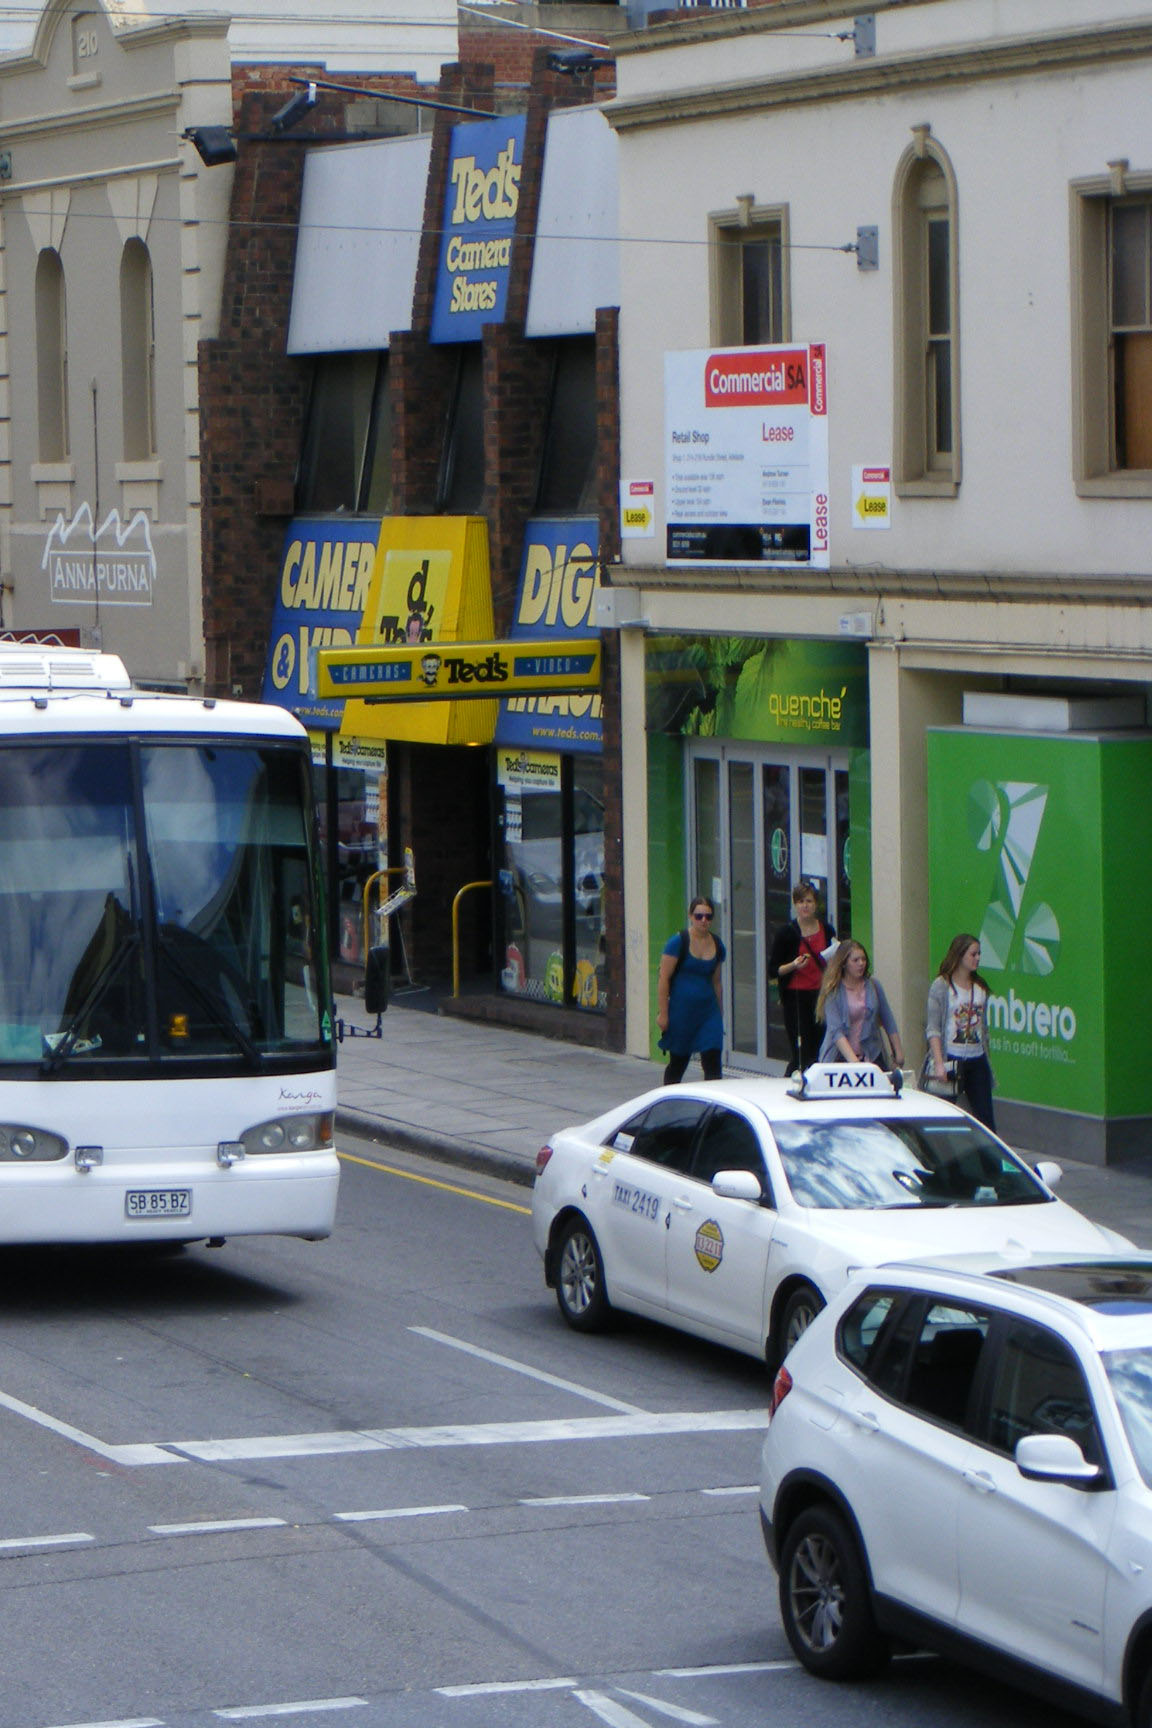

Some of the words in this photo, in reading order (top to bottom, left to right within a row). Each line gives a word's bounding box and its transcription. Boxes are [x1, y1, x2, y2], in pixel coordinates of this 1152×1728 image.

[451, 138, 522, 224] Ted's
[447, 236, 511, 272] Camera
[450, 276, 497, 313] Stores
[709, 363, 785, 395] Commercial
[786, 365, 806, 390] SA
[814, 359, 823, 411] Commercial
[671, 431, 690, 444] Retail
[692, 430, 709, 446] Shop
[761, 422, 794, 442] Lease
[626, 511, 646, 523] Lease
[864, 499, 886, 512] Lease
[813, 494, 828, 551] Lease
[54, 557, 149, 591] ANNAPURNA
[342, 666, 399, 681] CAMERAS
[444, 652, 508, 684] Ted's
[535, 657, 571, 673] VIDEO
[525, 761, 558, 776] cameras
[986, 988, 1077, 1041] mbrero
[824, 1072, 875, 1088] TAXI
[279, 1087, 322, 1104] Kanga
[129, 1194, 146, 1210] SB
[150, 1194, 167, 1209] 85
[170, 1193, 188, 1209] BZ
[614, 1185, 631, 1205] TAXI
[632, 1190, 659, 1220] 2419
